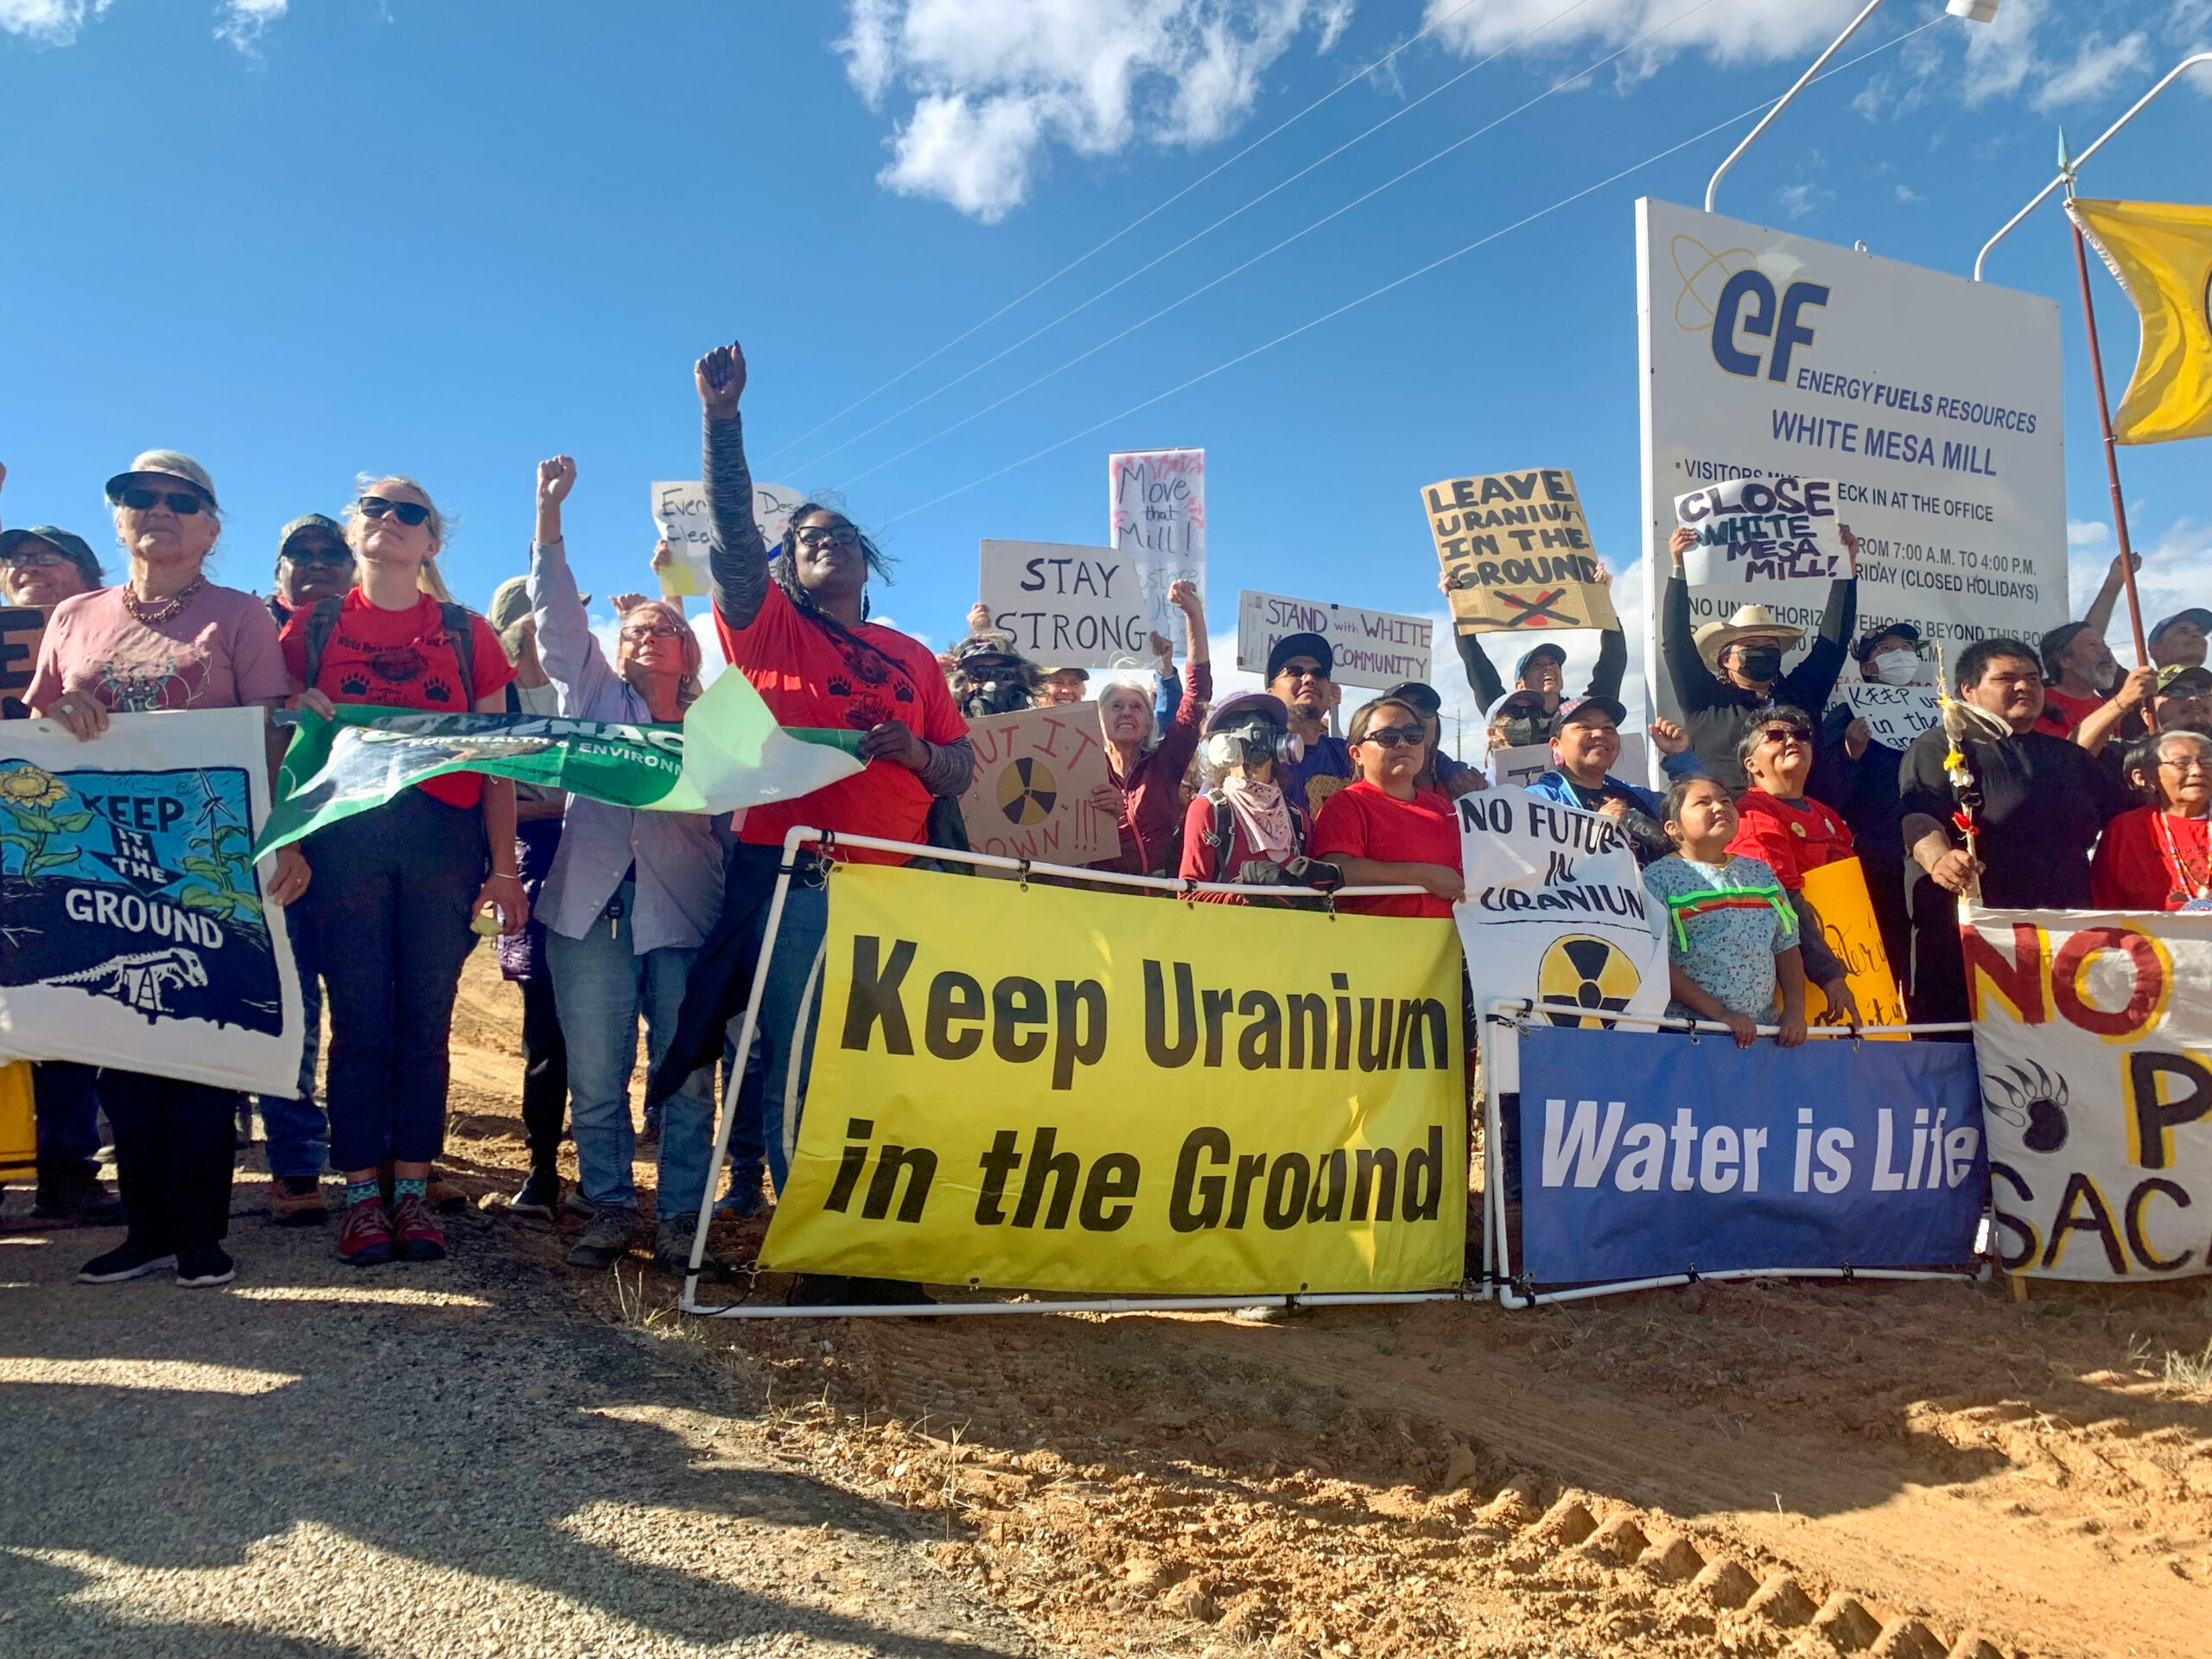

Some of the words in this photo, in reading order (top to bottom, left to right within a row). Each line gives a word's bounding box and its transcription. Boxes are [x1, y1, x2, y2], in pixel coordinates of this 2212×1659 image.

[1796, 368, 1873, 402] ENERGY
[1873, 385, 1933, 414] FUELS
[1936, 397, 2037, 434] RESOURCES
[1773, 410, 1858, 452] WHITE
[1865, 428, 1935, 466] MESA
[1942, 442, 1997, 476] MILL
[662, 487, 708, 517] Ever
[1119, 464, 1191, 504] Move
[1429, 471, 1574, 514] LEAVE
[1679, 478, 1834, 523] CLOSE
[1838, 483, 1868, 504] ECK
[1873, 488, 1887, 506] IN
[1891, 493, 1909, 509] AT
[1912, 494, 1940, 514] THE
[1944, 499, 1993, 522] OFFICE
[1142, 505, 1179, 521] that
[1694, 514, 1817, 546] WHITE
[667, 524, 710, 544] Clea
[1118, 522, 1192, 556] Mill!
[1441, 534, 1500, 561] IN
[1508, 527, 1590, 551] THE
[1726, 537, 1821, 563] MESA
[1450, 554, 1599, 590] GROUND
[1745, 556, 1840, 582] MILL!
[1858, 537, 1889, 557] ROM
[1894, 542, 1922, 562] 7:00
[1926, 546, 1955, 566] A.M.
[1959, 550, 1978, 569] TO
[1981, 555, 2008, 572] 4:00
[2012, 557, 2037, 575] P.M.
[1020, 558, 1120, 599] STAY
[1856, 563, 1897, 584] RIDAY
[1901, 569, 1962, 592] (CLOSED
[1967, 576, 2038, 604] HOLIDAYS)
[995, 611, 1147, 652] STRONG
[1266, 600, 1328, 633] STAND
[1334, 621, 1359, 633] with
[1360, 613, 1432, 649] WHITE
[1688, 597, 1713, 616] NO
[1927, 621, 1985, 642] BEYOND
[1332, 643, 1427, 678] COMMUNITY
[1848, 686, 1910, 709] KEEP
[461, 736, 549, 745] HEALTH
[1870, 714, 1895, 734] in
[1904, 711, 1939, 732] the
[970, 725, 1020, 766] UT
[1033, 716, 1099, 771] IT
[78, 791, 184, 833] KEEP
[1459, 798, 1512, 834] NO
[117, 828, 143, 846] IT
[122, 841, 151, 862] IN
[111, 856, 168, 883] THE
[66, 888, 224, 949] GROUND
[1961, 920, 2171, 1041] NO
[841, 934, 1108, 1090] Keep
[1142, 958, 1449, 1071] Uranium
[1541, 1099, 1767, 1193] Water
[1793, 1108, 1854, 1193] is
[1872, 1107, 1980, 1191] Life
[824, 1117, 938, 1224] in
[974, 1127, 1141, 1232] the
[1170, 1125, 1443, 1234] Ground
[1989, 1161, 2212, 1275] SAC
